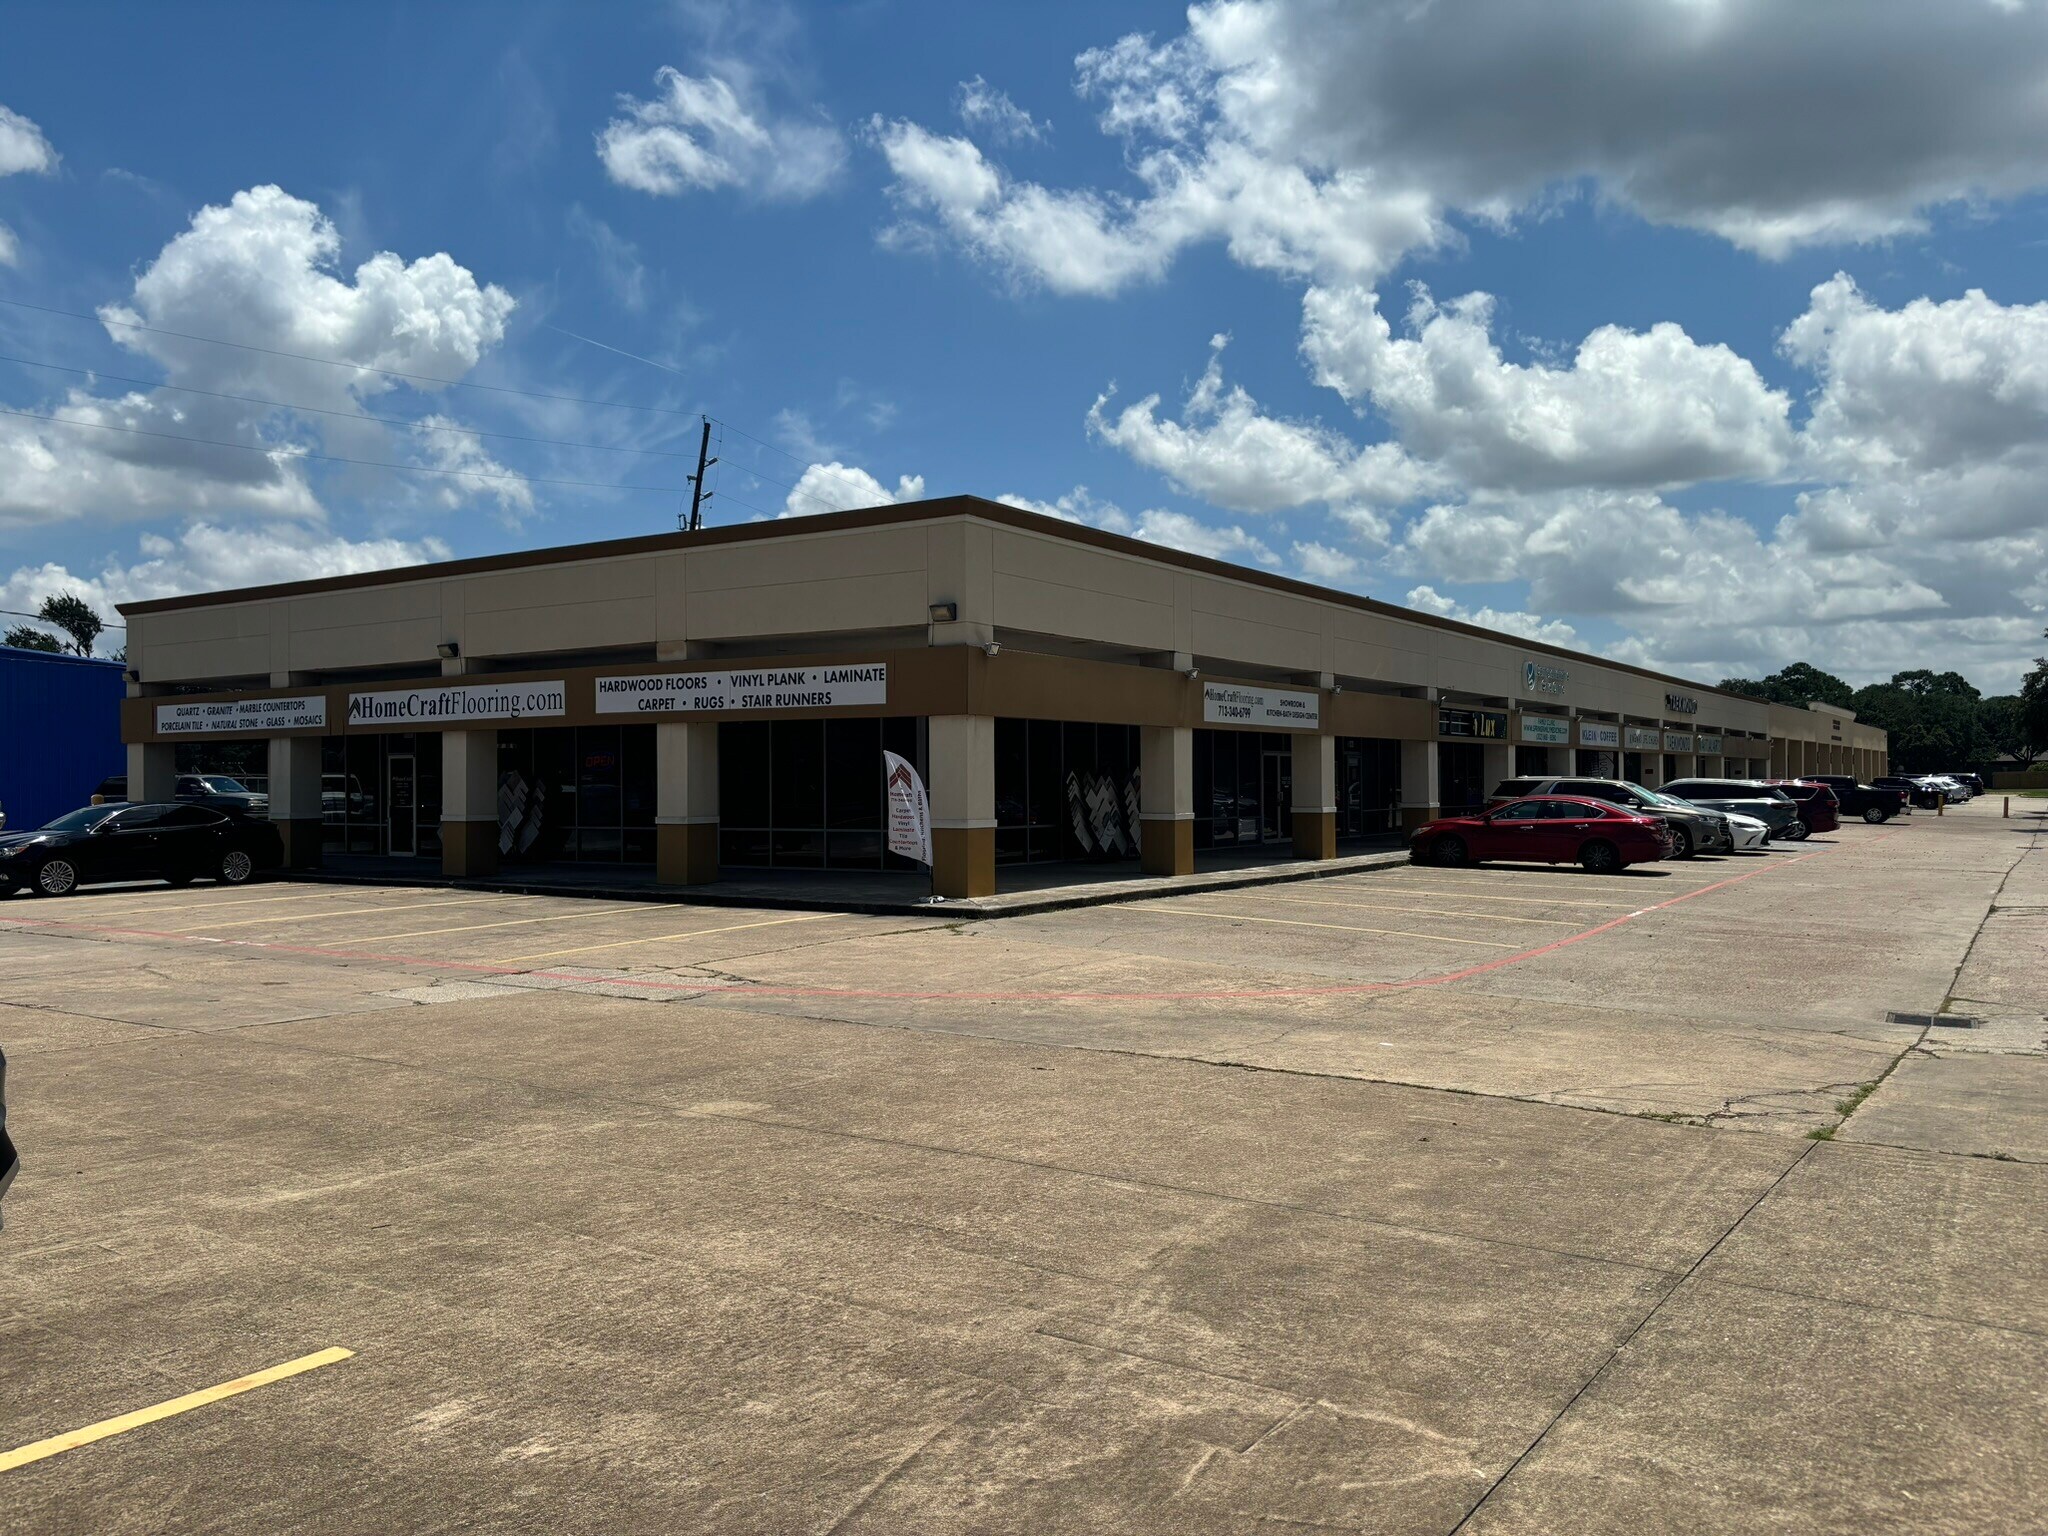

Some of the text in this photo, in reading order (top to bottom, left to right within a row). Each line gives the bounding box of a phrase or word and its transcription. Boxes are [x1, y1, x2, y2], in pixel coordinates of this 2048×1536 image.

[599, 668, 885, 692] HARDWOOD FLOORS VINYL PLANK LAMINATE
[176, 701, 305, 717] QUARTZ GRANITE MARBLE COUNTERTOPS
[362, 689, 564, 718] HomeCraftFlooring.com
[638, 692, 832, 710] CARPET RUGS STAIR RUNNERS
[161, 715, 322, 731] PORCELAIN TILE NATURAL STONE GLASS MOSAICS
[1600, 731, 1617, 742] COFFEE
[585, 755, 615, 768] OPEN
